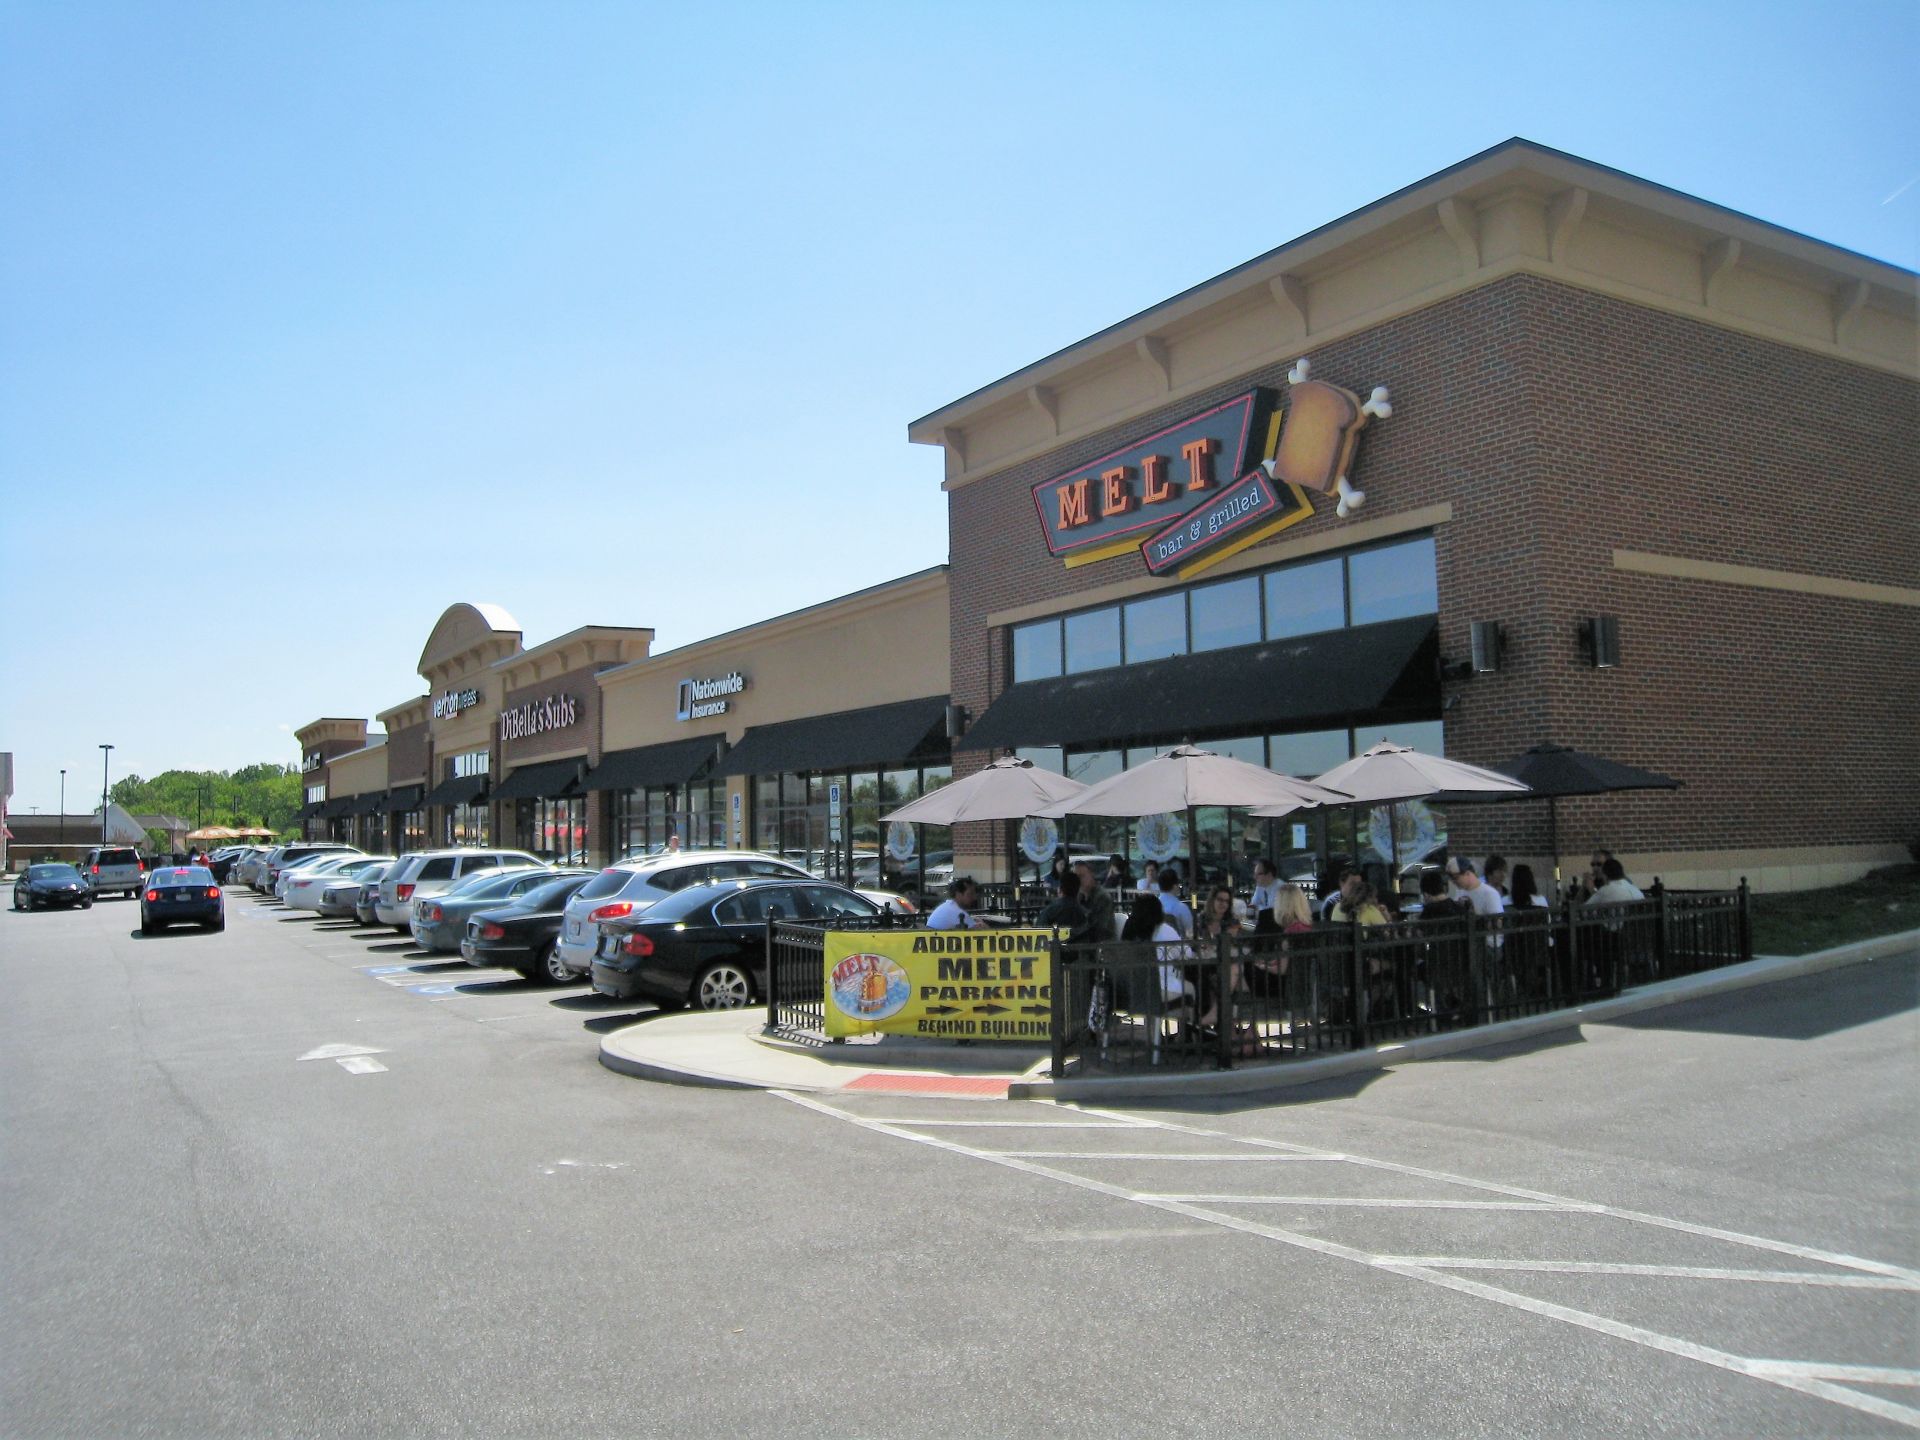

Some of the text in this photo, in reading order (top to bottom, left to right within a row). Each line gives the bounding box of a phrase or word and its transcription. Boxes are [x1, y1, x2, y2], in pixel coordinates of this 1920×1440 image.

[1057, 438, 1211, 529] MELT
[1158, 488, 1260, 559] bar & grilled
[692, 672, 743, 700] Nationwide
[501, 694, 575, 741] DiBella's Subs
[692, 701, 726, 719] Insurance
[912, 934, 1051, 953] ADDITIONA
[832, 955, 879, 990] MELT
[938, 956, 1039, 981] MELT
[918, 1019, 1051, 1036] BEHIND BUILDIN
